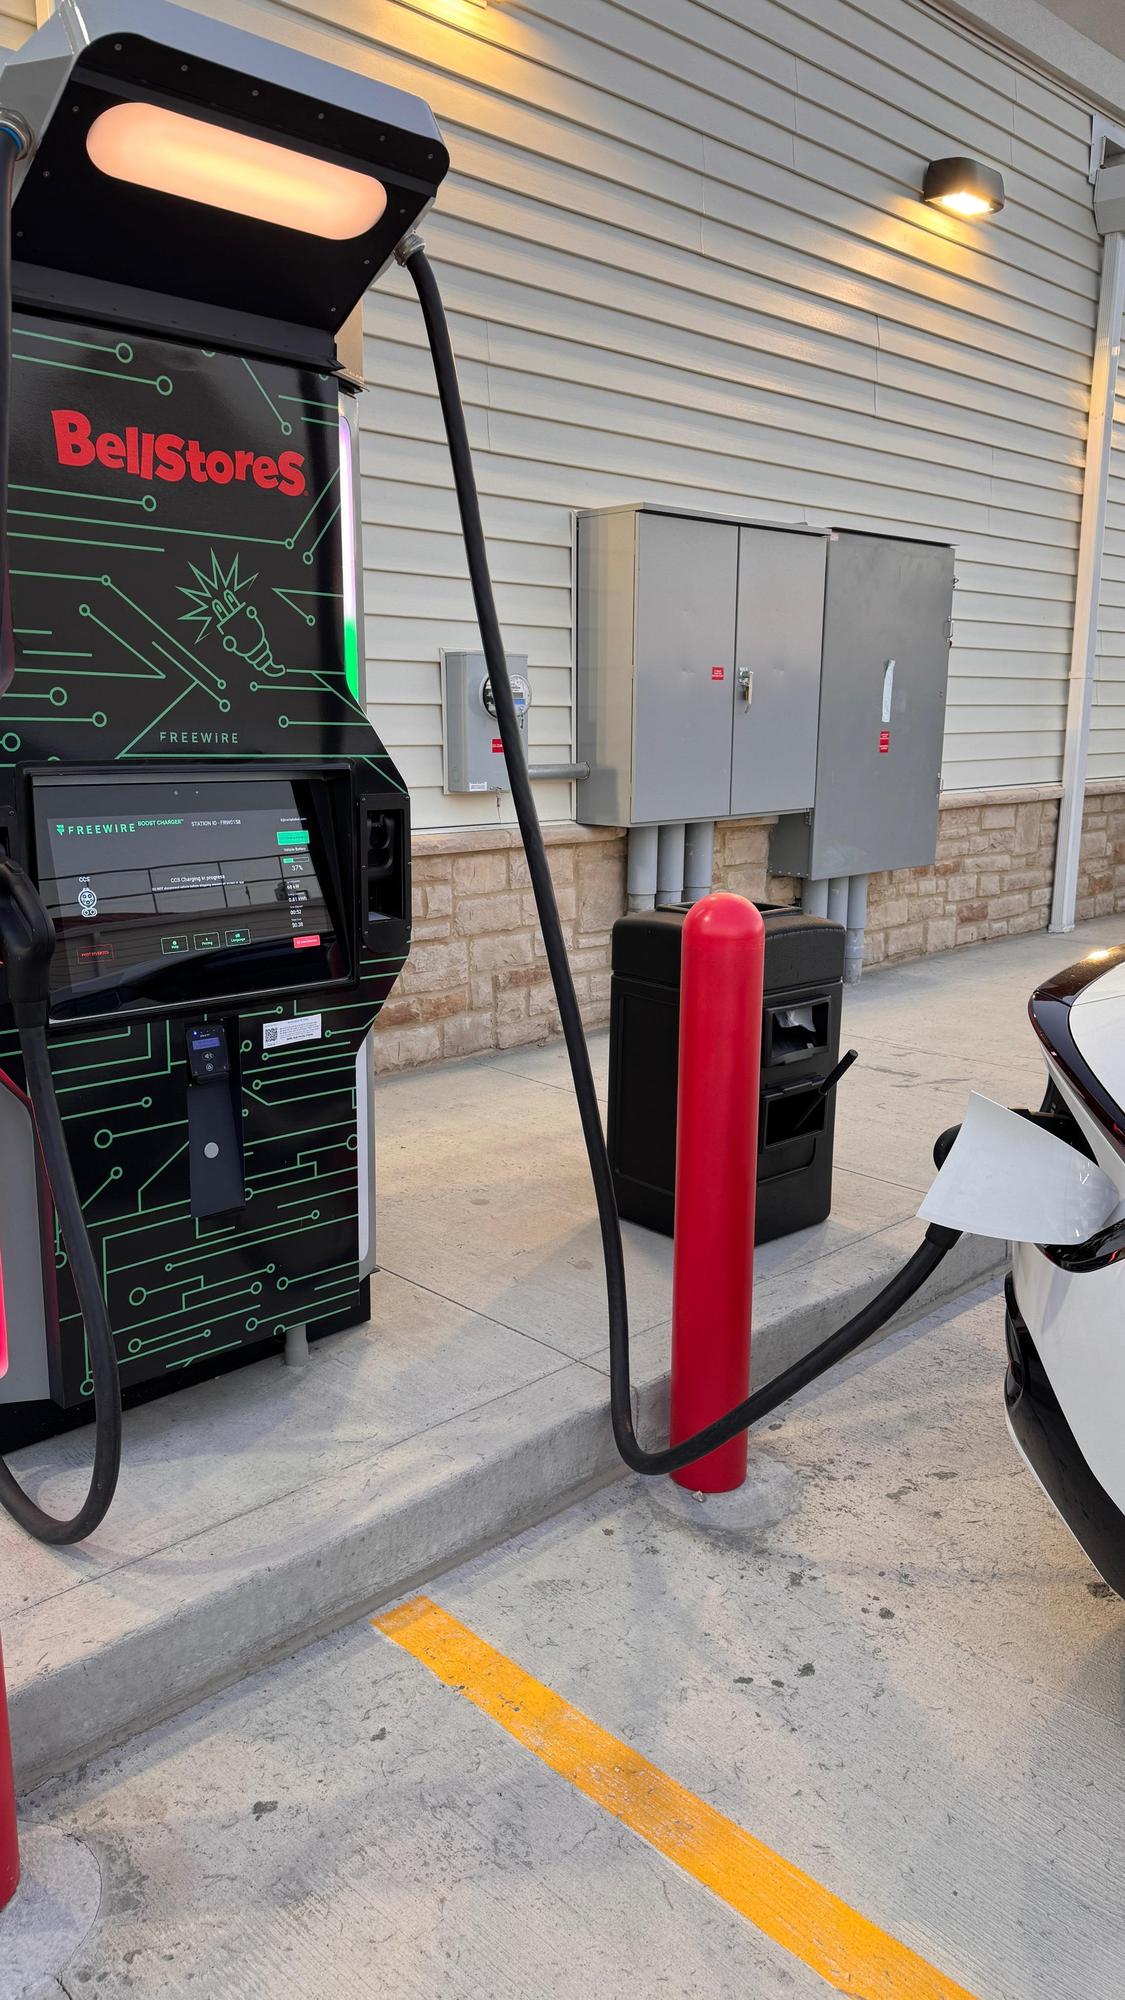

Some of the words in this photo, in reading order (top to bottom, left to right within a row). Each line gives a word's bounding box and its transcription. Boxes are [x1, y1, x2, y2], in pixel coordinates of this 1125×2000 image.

[51, 409, 306, 497] BellStores
[159, 731, 239, 744] FREEWIRE
[68, 823, 136, 835] FREEWIRE
[181, 875, 201, 883] Charging
